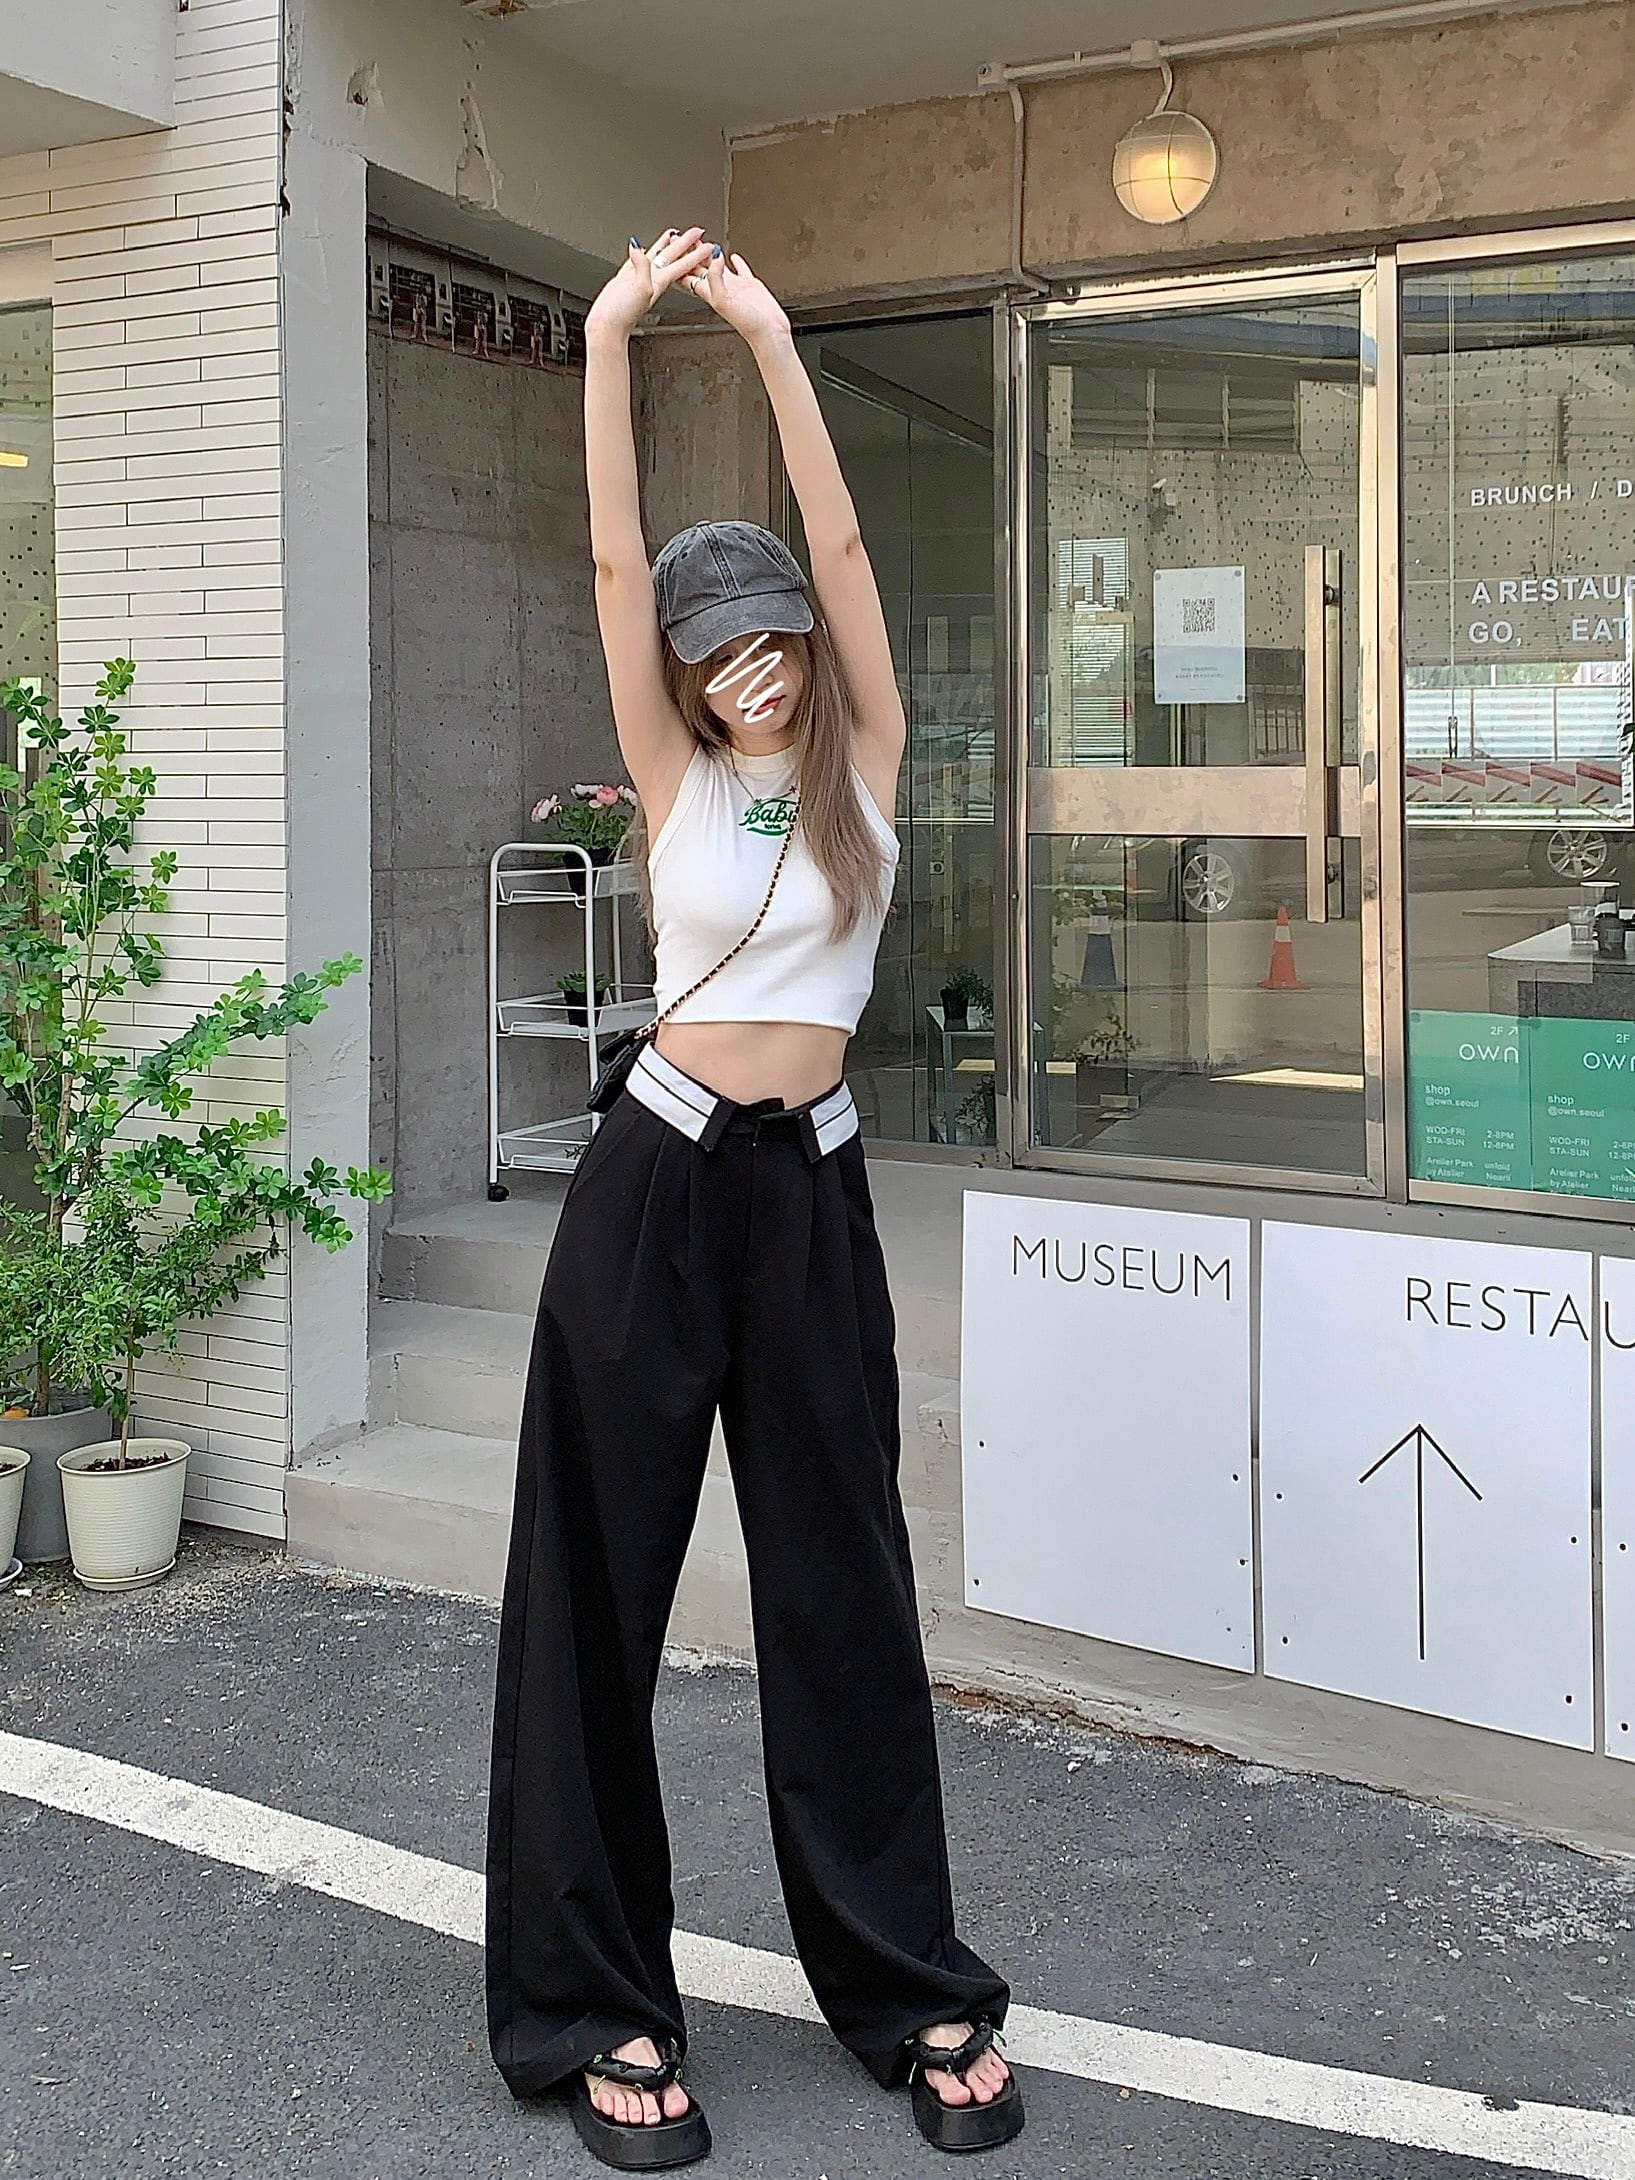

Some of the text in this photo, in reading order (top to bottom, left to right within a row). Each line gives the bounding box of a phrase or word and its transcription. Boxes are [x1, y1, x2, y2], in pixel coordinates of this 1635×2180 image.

[1471, 483, 1572, 507] BRUNCH
[1590, 481, 1598, 499] /
[1471, 582, 1491, 604] A
[1468, 618, 1629, 646] GO, EAT
[1490, 1026, 1503, 1036] 2F
[1616, 1034, 1630, 1043] 2F
[1459, 1043, 1519, 1063] own
[1425, 1084, 1451, 1096] shop
[1425, 1097, 1479, 1108] @own.seoul
[1548, 1094, 1574, 1106] shop
[1548, 1106, 1605, 1117] @own.seoul
[1013, 1234, 1230, 1301] MUSEUM
[1407, 1277, 1635, 1349] RESTAU
